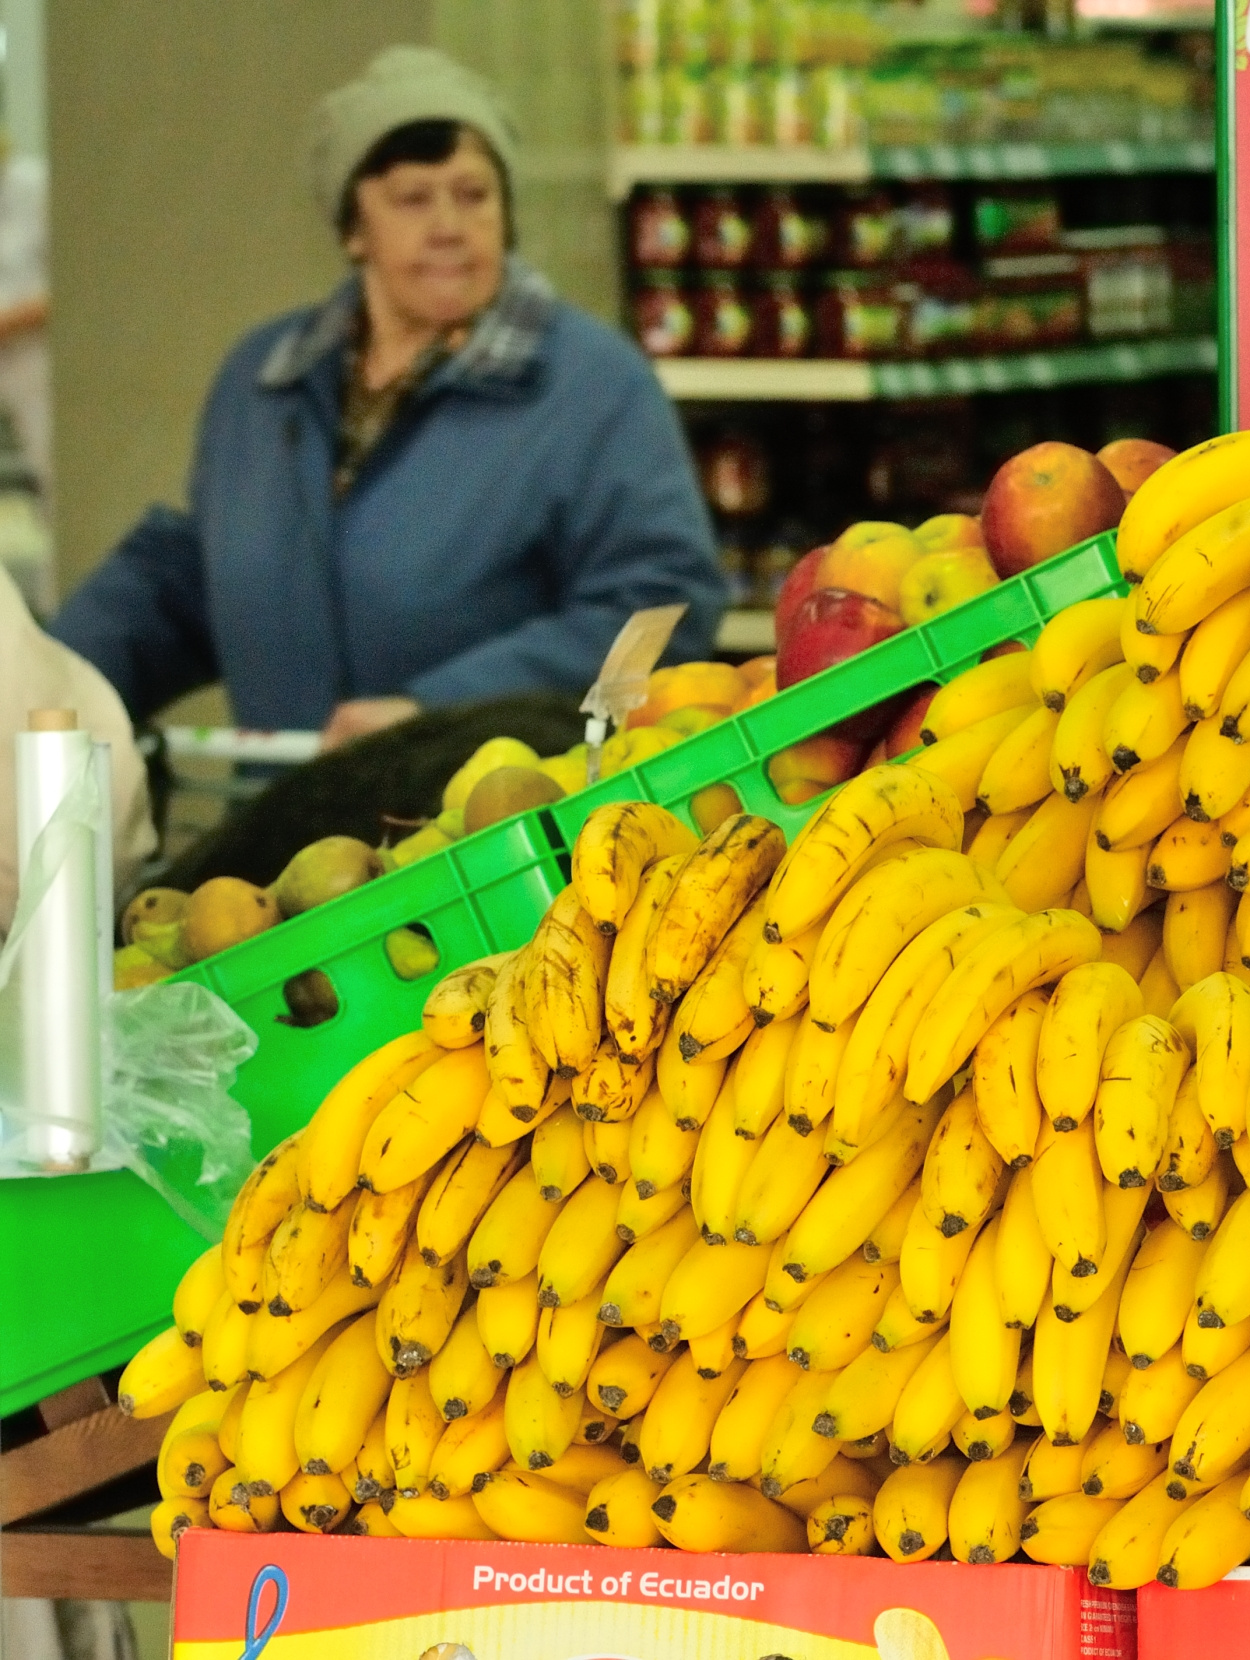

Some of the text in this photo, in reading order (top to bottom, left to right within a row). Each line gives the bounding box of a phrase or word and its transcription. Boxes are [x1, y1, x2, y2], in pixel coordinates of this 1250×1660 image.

[473, 1565, 765, 1601] Product of Ecuador
